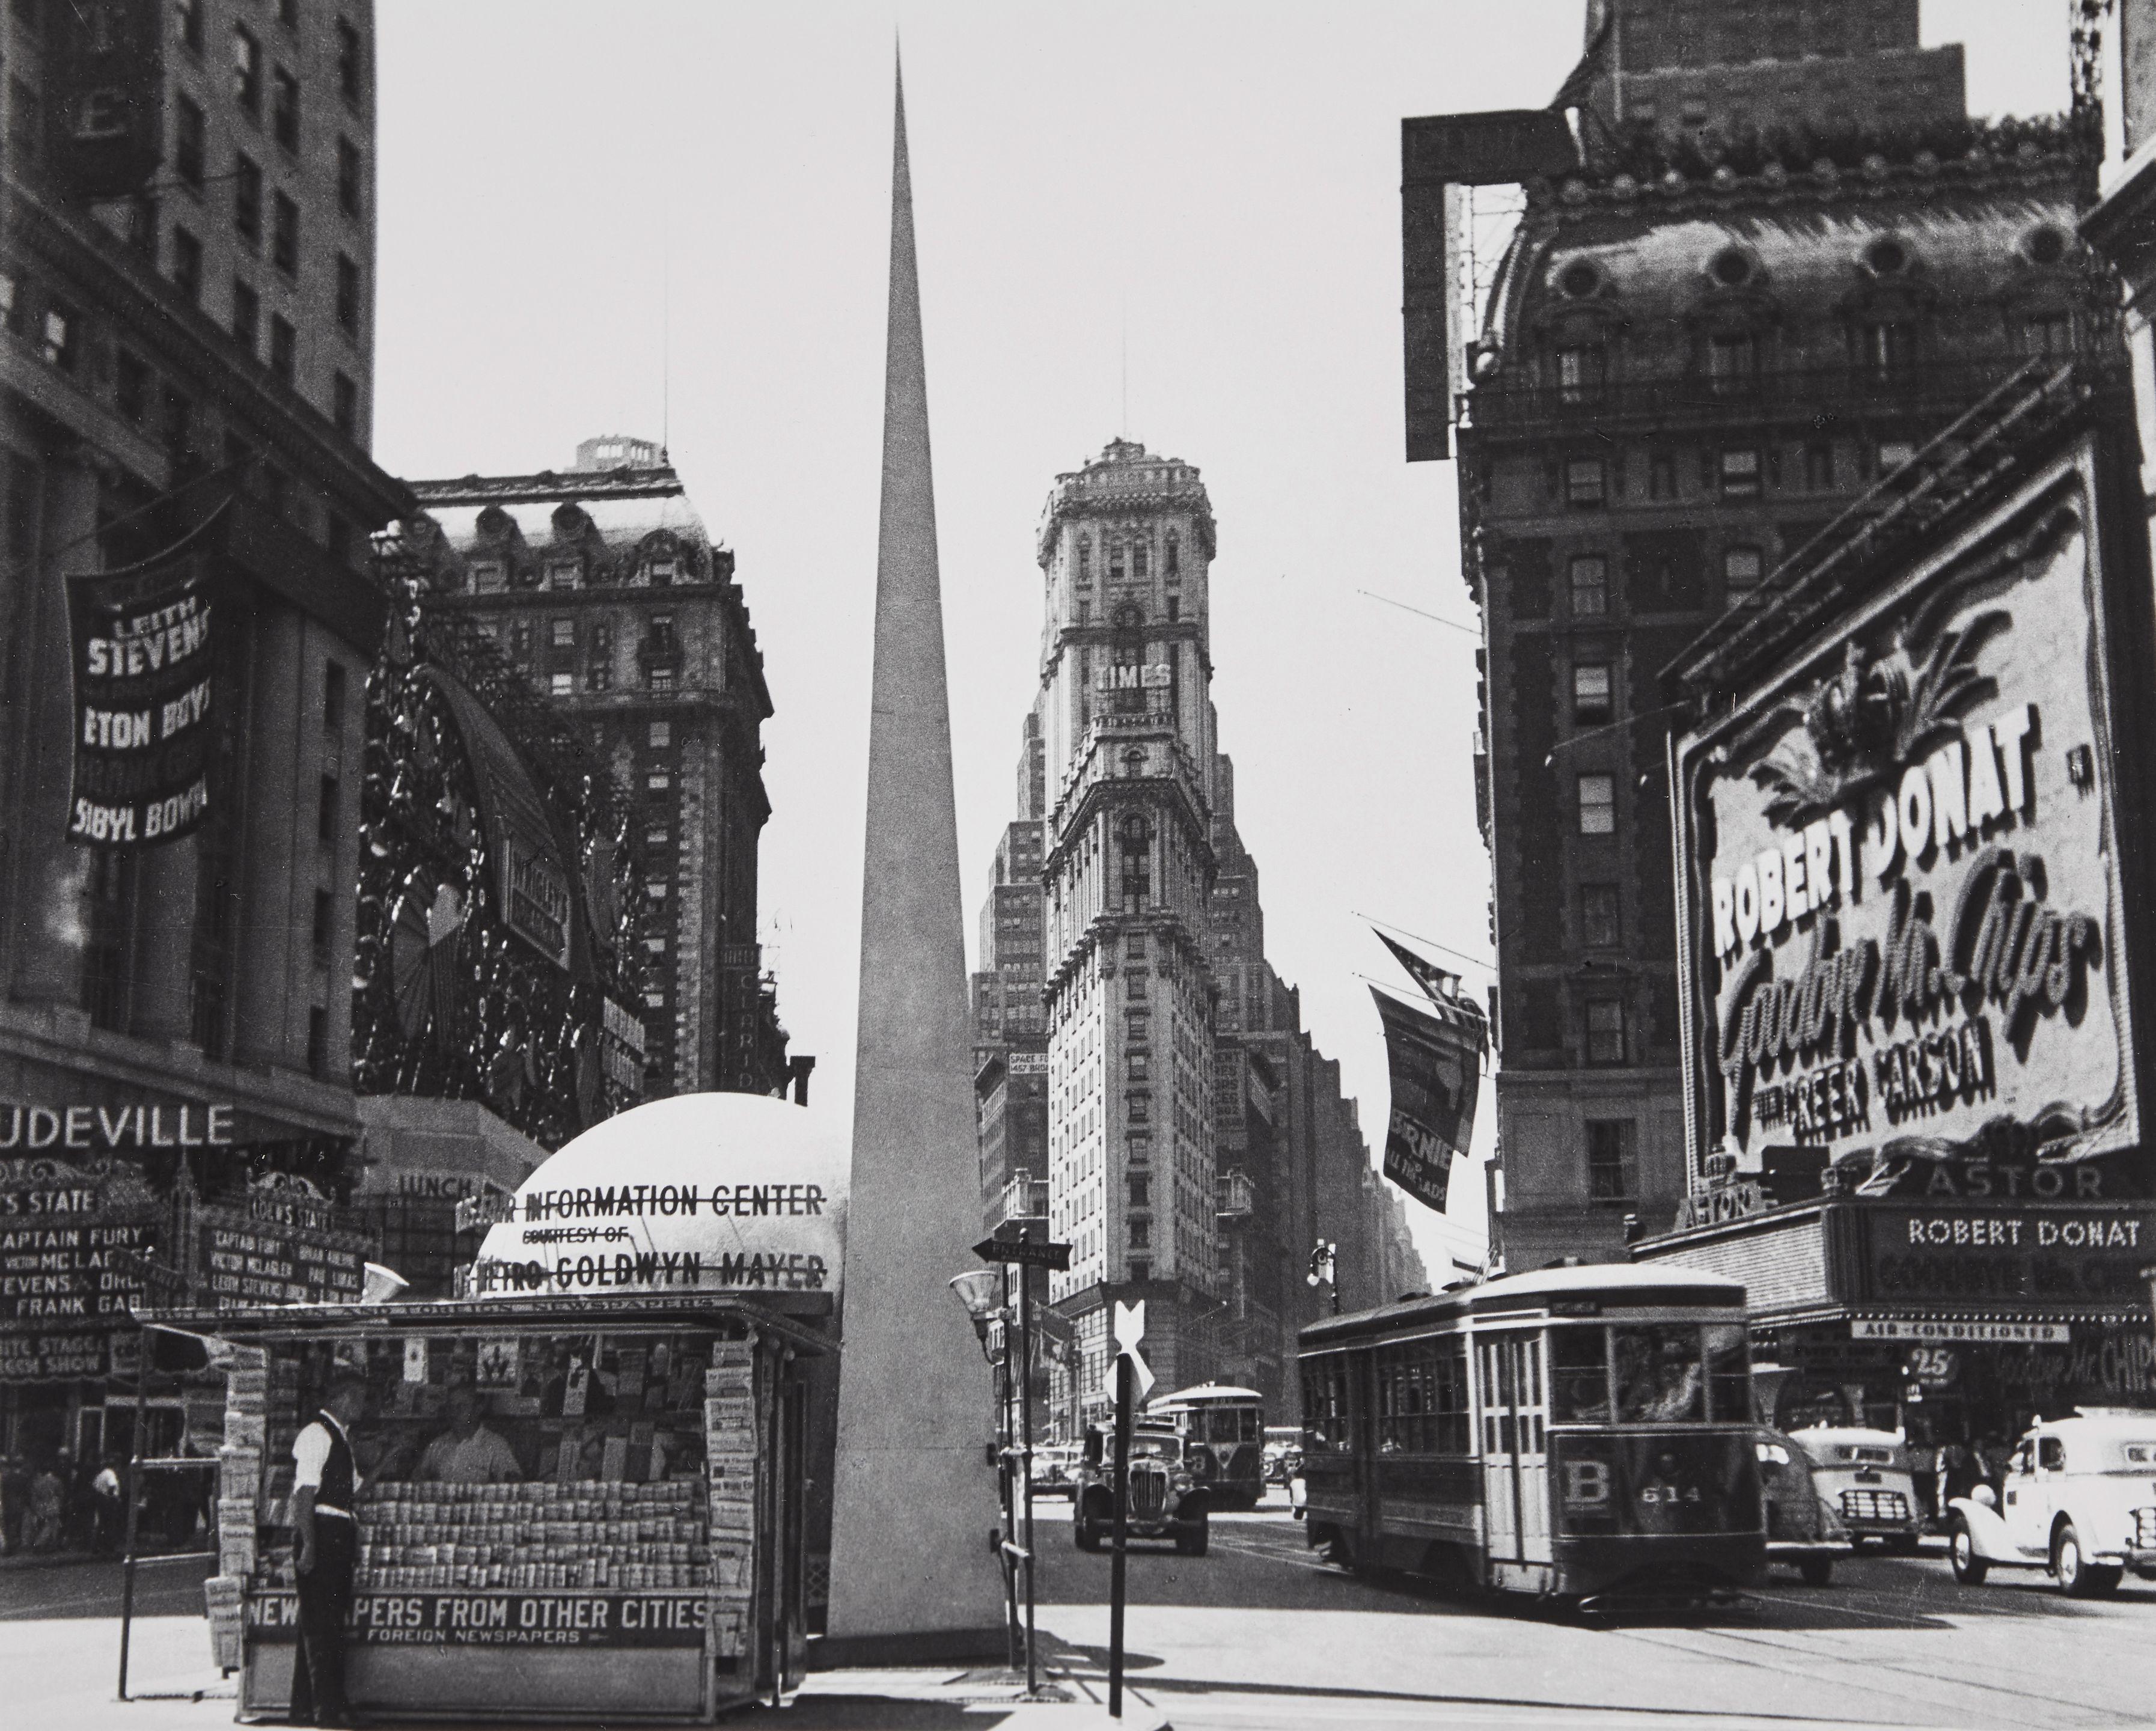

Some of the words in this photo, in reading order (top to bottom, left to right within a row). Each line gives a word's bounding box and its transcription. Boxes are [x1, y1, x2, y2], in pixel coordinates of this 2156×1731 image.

[113, 594, 197, 638] LEITH
[84, 705, 151, 749] ETON
[72, 796, 136, 842] SIBYL
[1711, 809, 1855, 960] ROBERT
[1390, 1110, 1452, 1170] BRNIE
[1926, 1164, 2103, 1198] ASTOR
[28, 1189, 94, 1213] STATE
[525, 1185, 698, 1223] INFORMATION
[712, 1185, 823, 1216] CENTER
[90, 1227, 142, 1247] FURY
[604, 1226, 630, 1243] OF
[1908, 1219, 2023, 1246] ROBERT
[2037, 1220, 2140, 1249] DONAT
[555, 1252, 701, 1289] GOLDWYN
[721, 1252, 823, 1289] MAYER
[17, 1297, 85, 1316] FRANK
[1564, 1460, 1609, 1503] B
[1640, 1485, 1702, 1503] 614
[435, 1598, 507, 1627] FROM
[520, 1599, 608, 1629] OTHER
[621, 1599, 706, 1629] CITIES
[367, 1629, 445, 1642] FOREIGN
[456, 1629, 579, 1643] NEWSPAPERS
